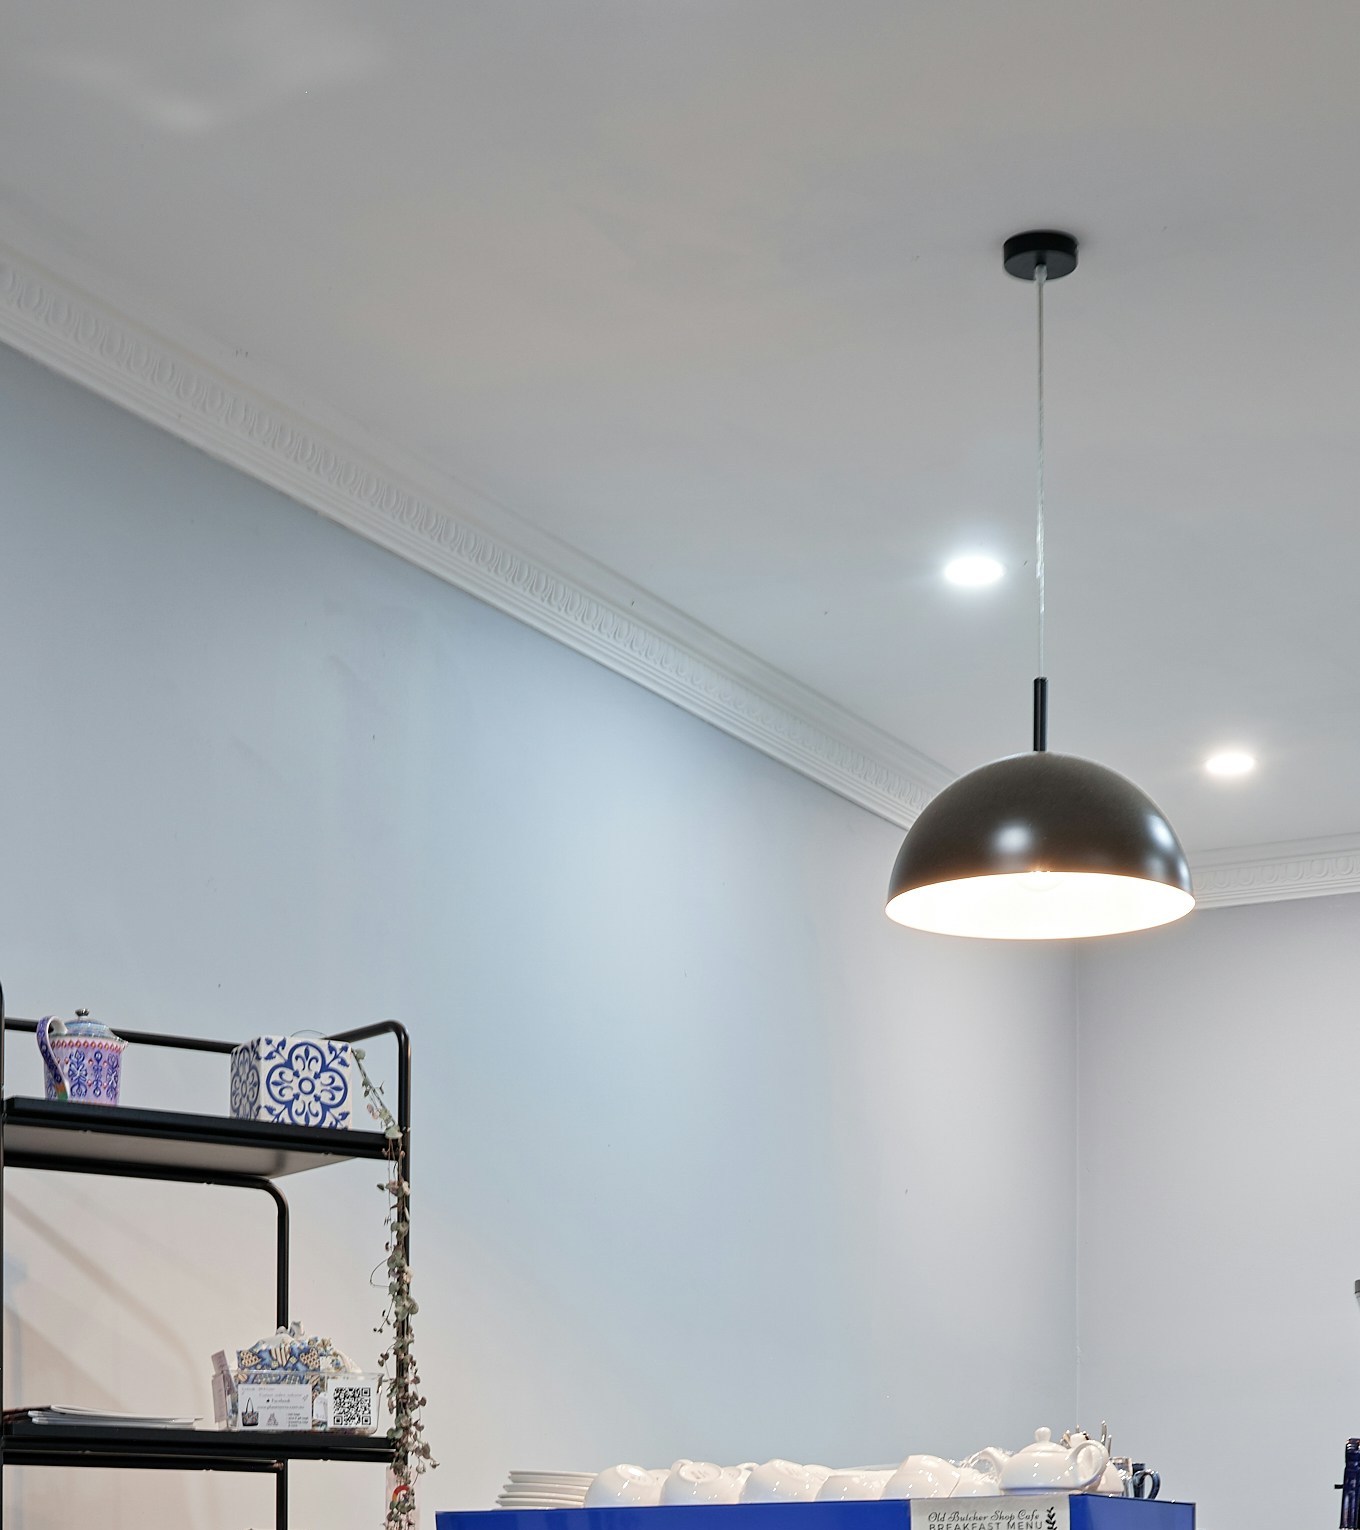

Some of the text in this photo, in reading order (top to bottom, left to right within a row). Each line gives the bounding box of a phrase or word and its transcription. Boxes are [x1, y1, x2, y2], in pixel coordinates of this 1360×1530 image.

[928, 1508, 1040, 1523] Old Butcher Shop Cafe
[1007, 1521, 1043, 1530] MENU
